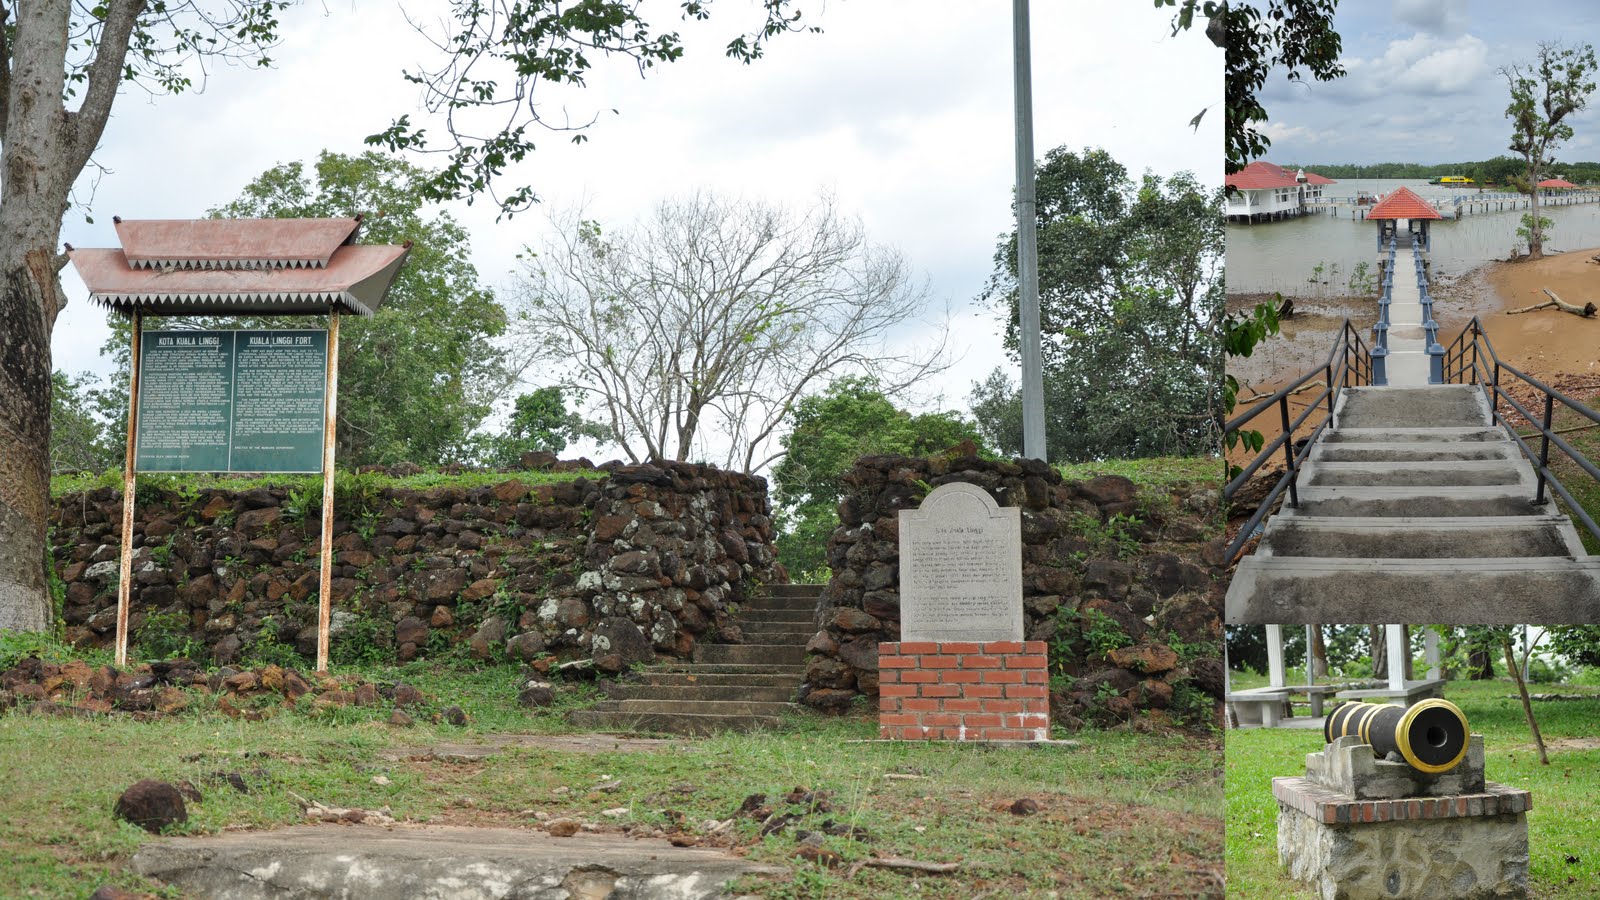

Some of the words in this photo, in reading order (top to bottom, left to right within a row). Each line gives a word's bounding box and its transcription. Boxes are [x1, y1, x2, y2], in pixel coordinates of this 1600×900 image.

[158, 337, 174, 345] KOTA
[176, 337, 196, 345] KUALA
[198, 336, 220, 345] LINGGI
[249, 336, 270, 345] KUALA
[272, 336, 293, 345] LINGGI
[295, 336, 312, 345] FORT
